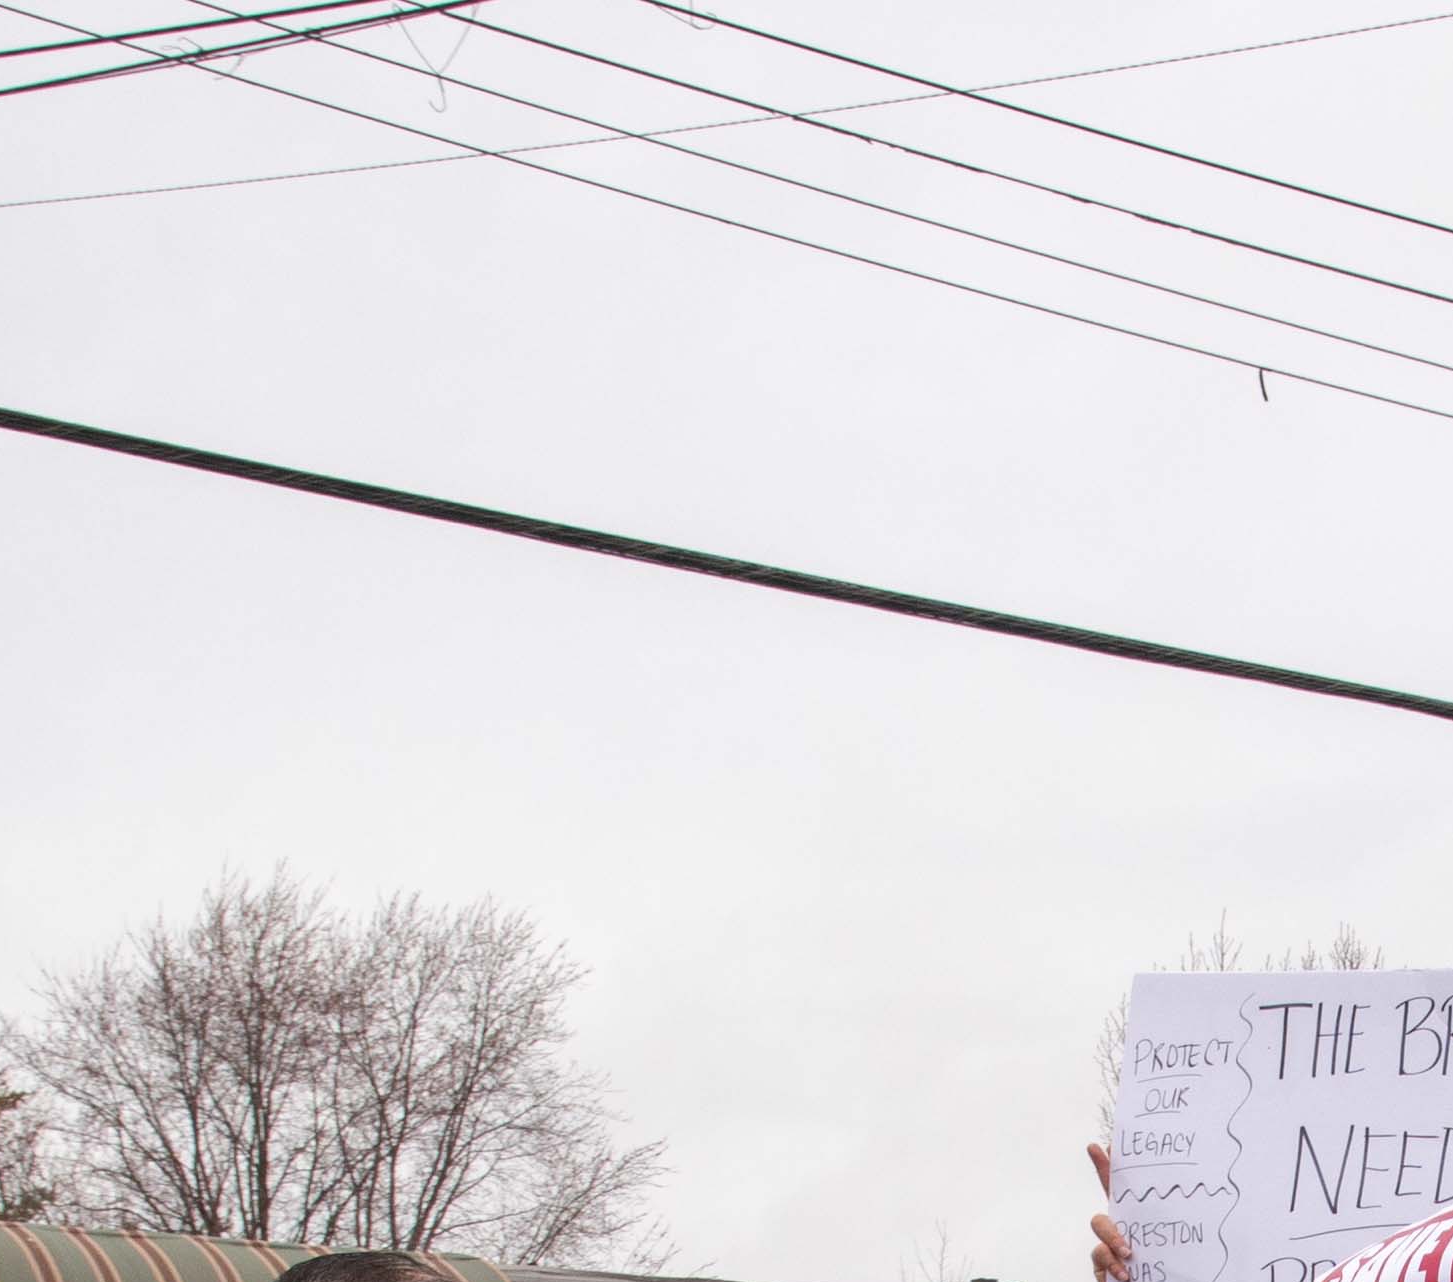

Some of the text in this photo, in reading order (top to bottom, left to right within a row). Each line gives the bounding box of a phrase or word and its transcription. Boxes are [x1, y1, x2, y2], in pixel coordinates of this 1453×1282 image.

[1134, 1037, 1234, 1076] PROTECT
[1258, 1002, 1372, 1080] THE
[1120, 1130, 1197, 1158] LEGACY
